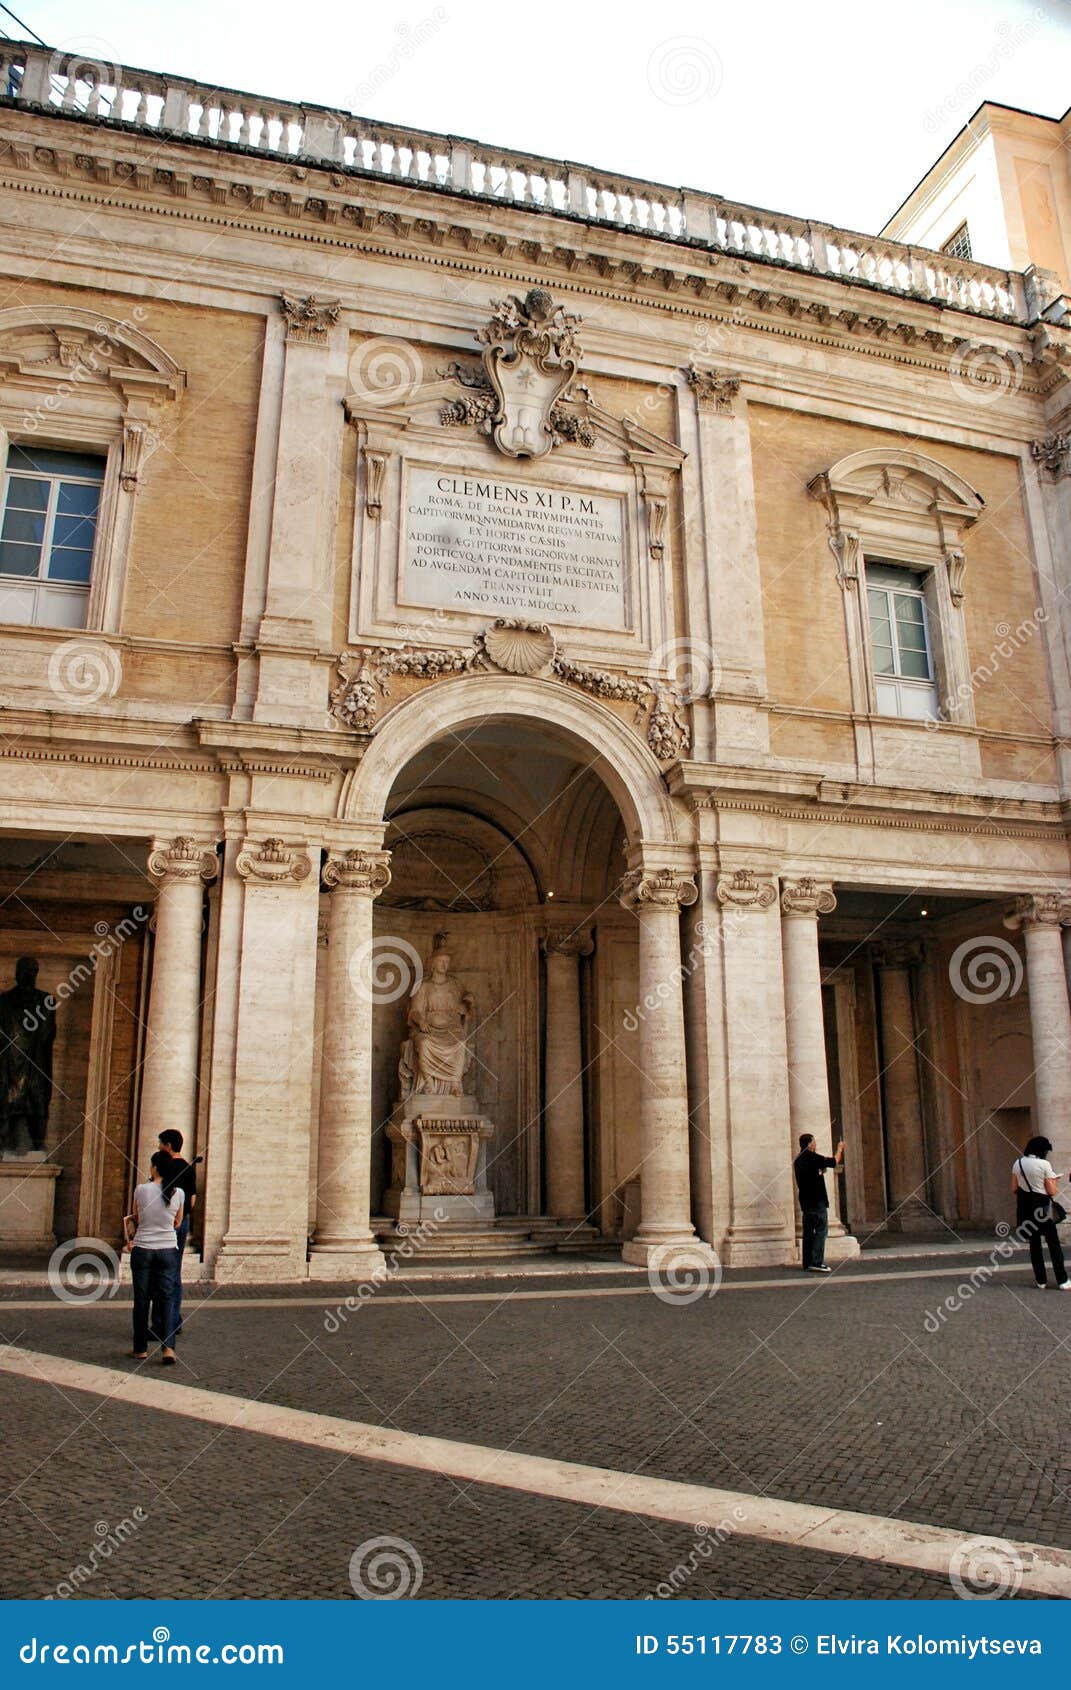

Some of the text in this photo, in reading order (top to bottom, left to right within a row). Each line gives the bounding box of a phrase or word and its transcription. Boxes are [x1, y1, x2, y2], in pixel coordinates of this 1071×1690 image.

[437, 477, 600, 515] CLEMENS XI P. M.
[468, 501, 482, 511] DE
[488, 504, 522, 516] DACIA
[526, 509, 604, 529] TRIVMPHANTIS
[469, 526, 482, 537] EX
[486, 528, 526, 541] HORTIS
[547, 525, 582, 538] REGVM
[409, 532, 451, 545] ADDITO
[525, 547, 579, 562] SIGNORVM
[581, 555, 621, 568] ORNATV
[410, 558, 427, 568] AD
[430, 560, 491, 577] AVGENDAM
[552, 576, 620, 593] MAIESTATEM
[487, 554, 562, 573] FVNDAMENTIS
[566, 565, 615, 580] EXCITATA
[455, 590, 489, 602] ANNO
[482, 580, 552, 598] TRANSTVLIT
